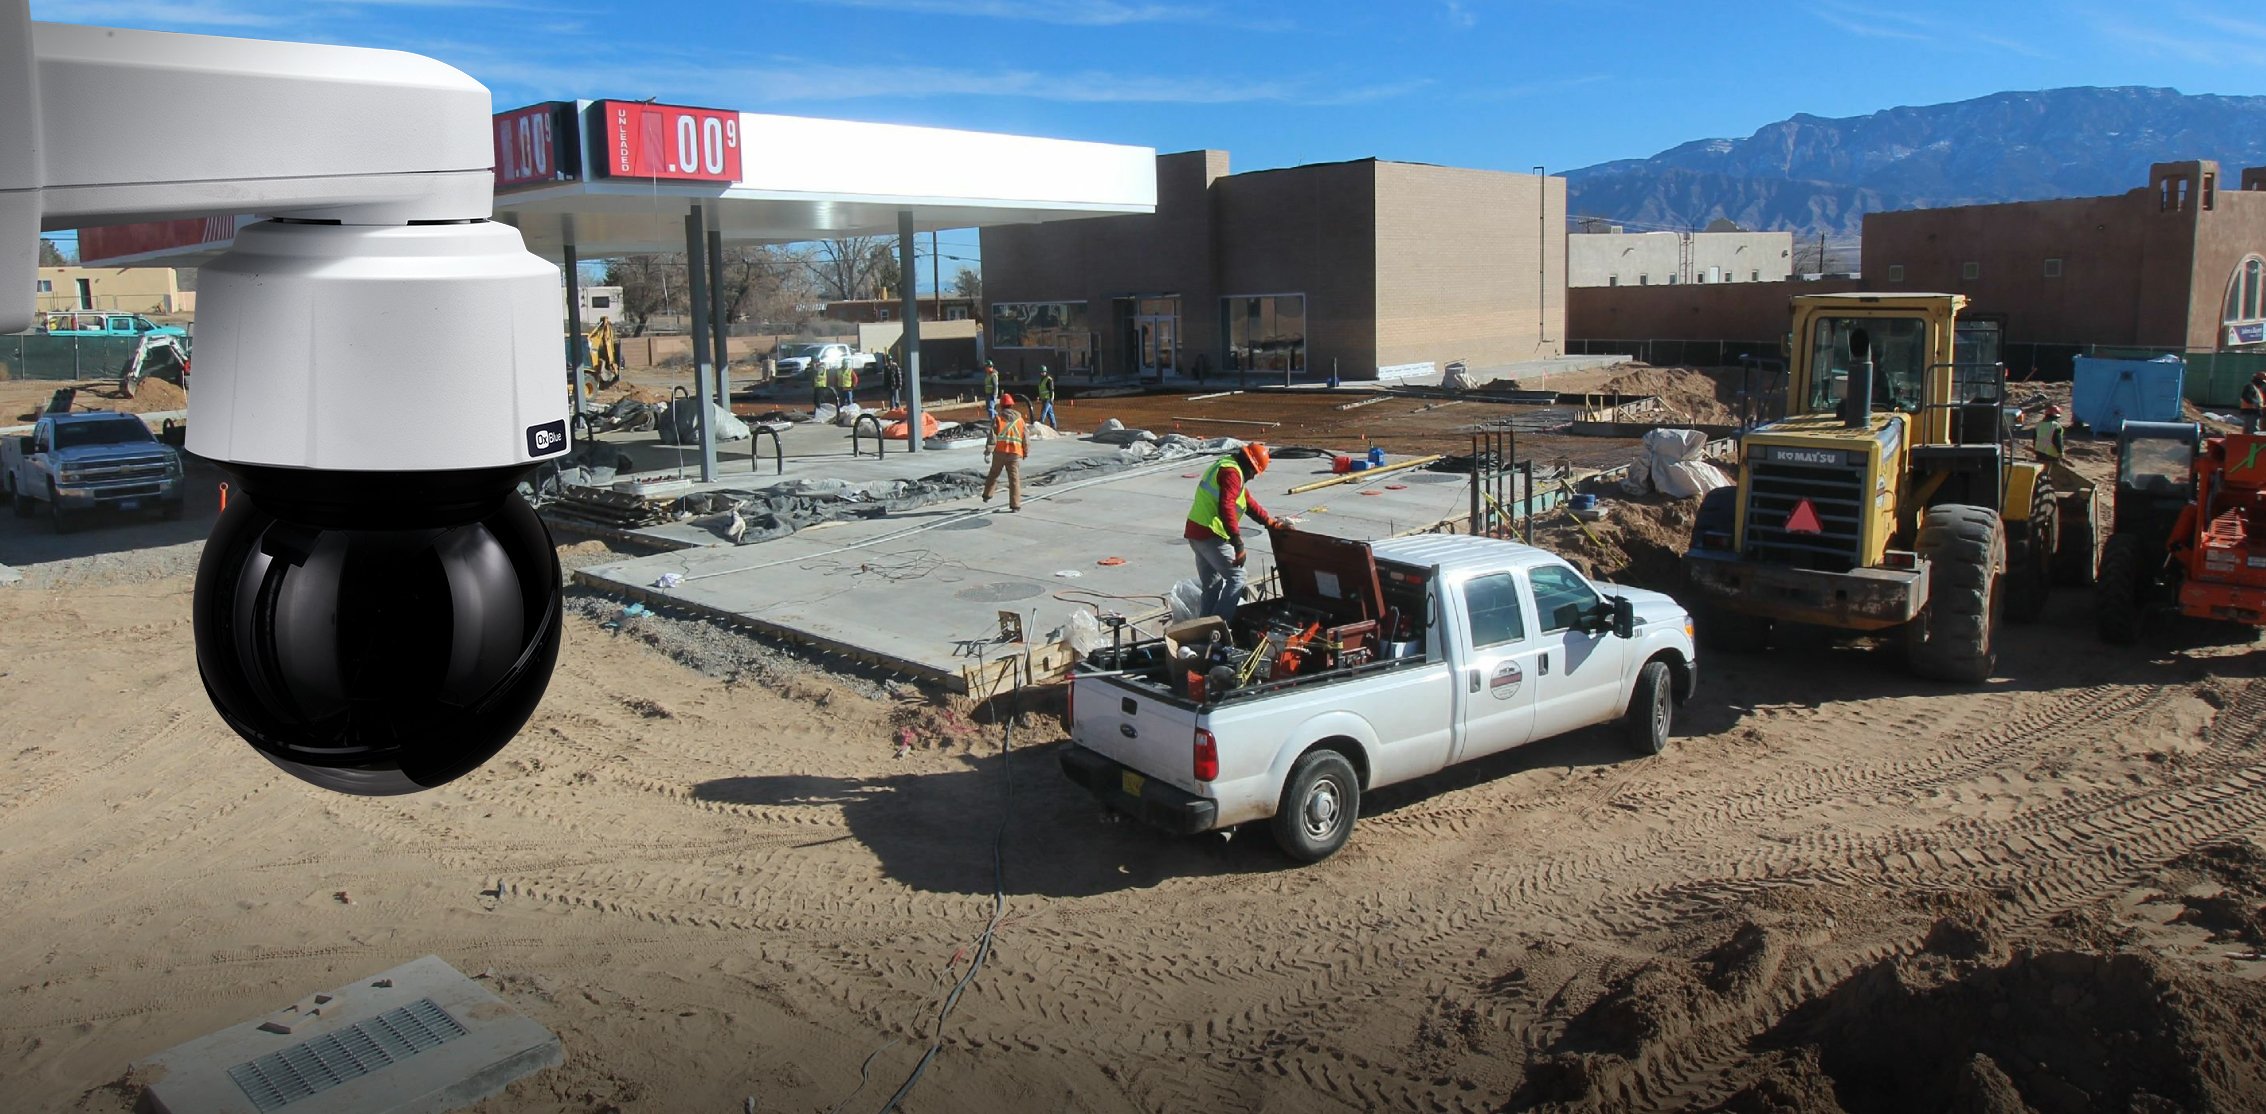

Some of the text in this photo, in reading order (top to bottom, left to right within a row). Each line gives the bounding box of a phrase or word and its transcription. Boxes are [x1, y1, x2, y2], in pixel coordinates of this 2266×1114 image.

[618, 109, 630, 172] UNLEADED
[537, 431, 562, 446] OxBlue
[1777, 451, 1836, 464] KOMATSU
